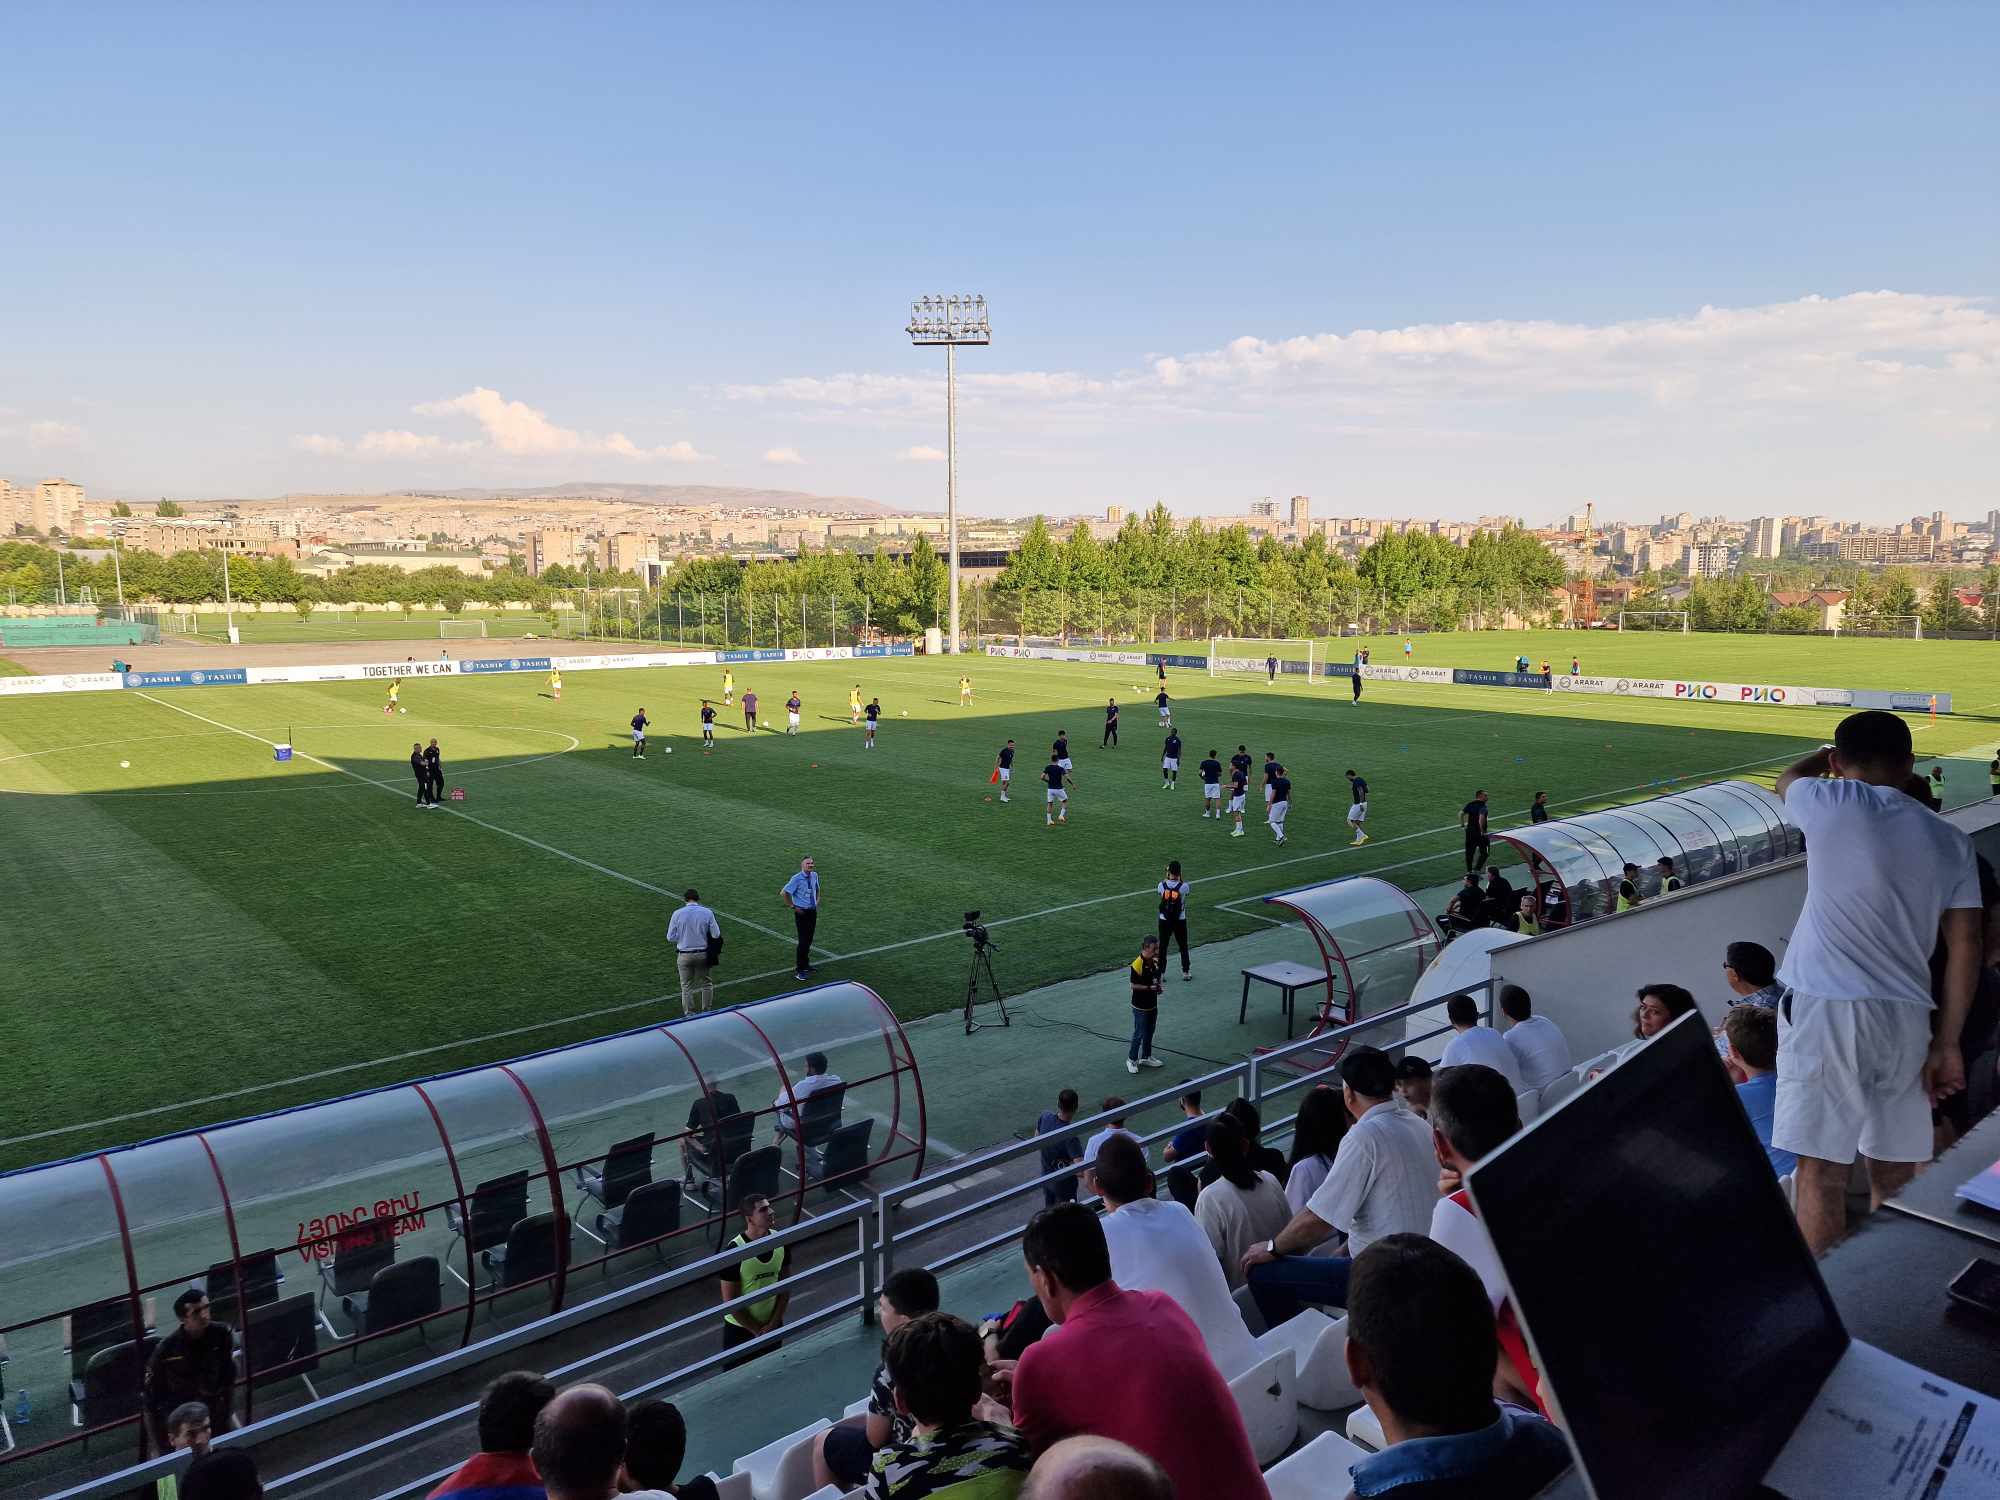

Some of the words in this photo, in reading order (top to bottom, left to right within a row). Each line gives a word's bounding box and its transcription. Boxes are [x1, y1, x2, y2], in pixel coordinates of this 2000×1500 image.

[362, 665, 412, 677] TOGETHER
[415, 664, 430, 675] WE
[432, 663, 452, 673] CAN
[144, 674, 182, 683] TASHIR
[208, 673, 242, 681] TASHIR
[1574, 679, 1604, 687] ARARAT
[1632, 682, 1665, 690] ARARAT
[1675, 683, 1717, 699] РИО
[1741, 687, 1786, 702] РИО
